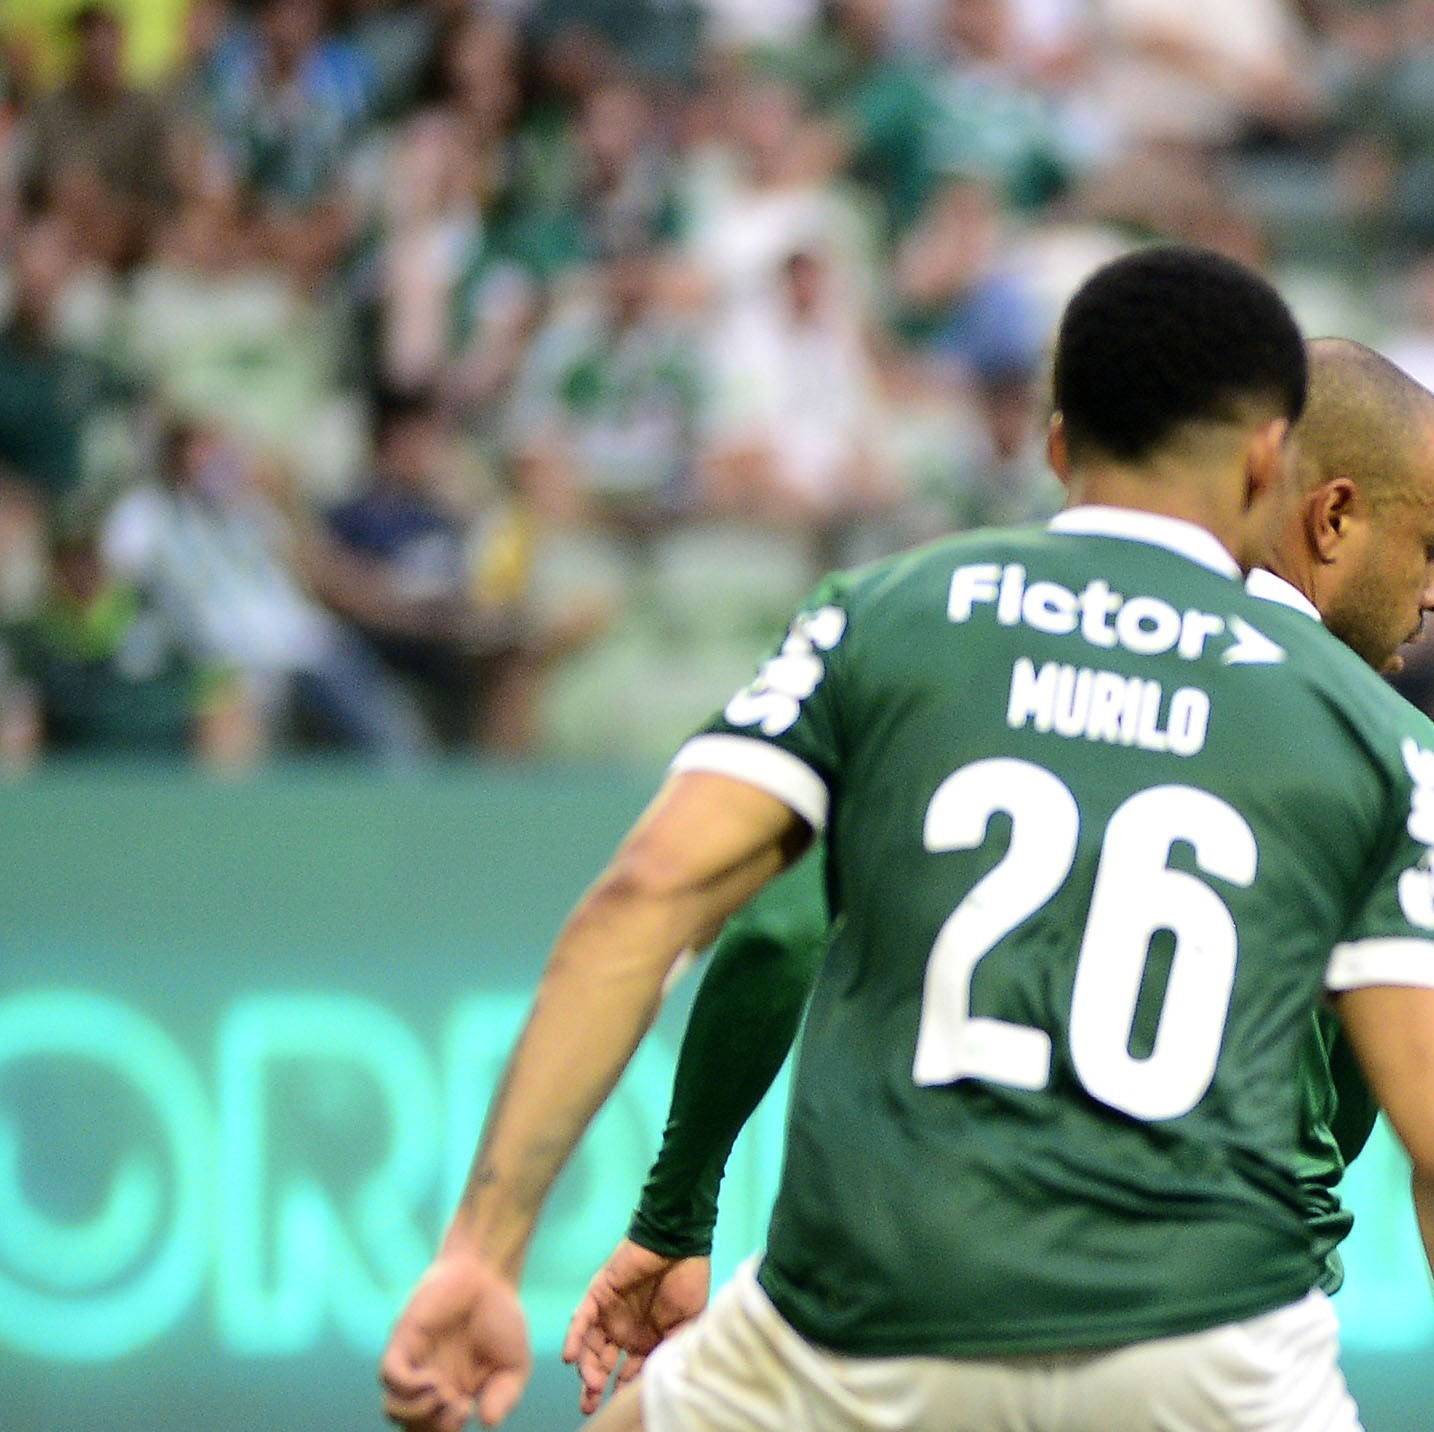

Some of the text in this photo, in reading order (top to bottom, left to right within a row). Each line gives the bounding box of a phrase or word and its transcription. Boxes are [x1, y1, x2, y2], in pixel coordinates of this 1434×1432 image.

[947, 562, 1226, 661] Fictor
[1005, 656, 1211, 757] MURILO
[911, 756, 1259, 1121] 26
